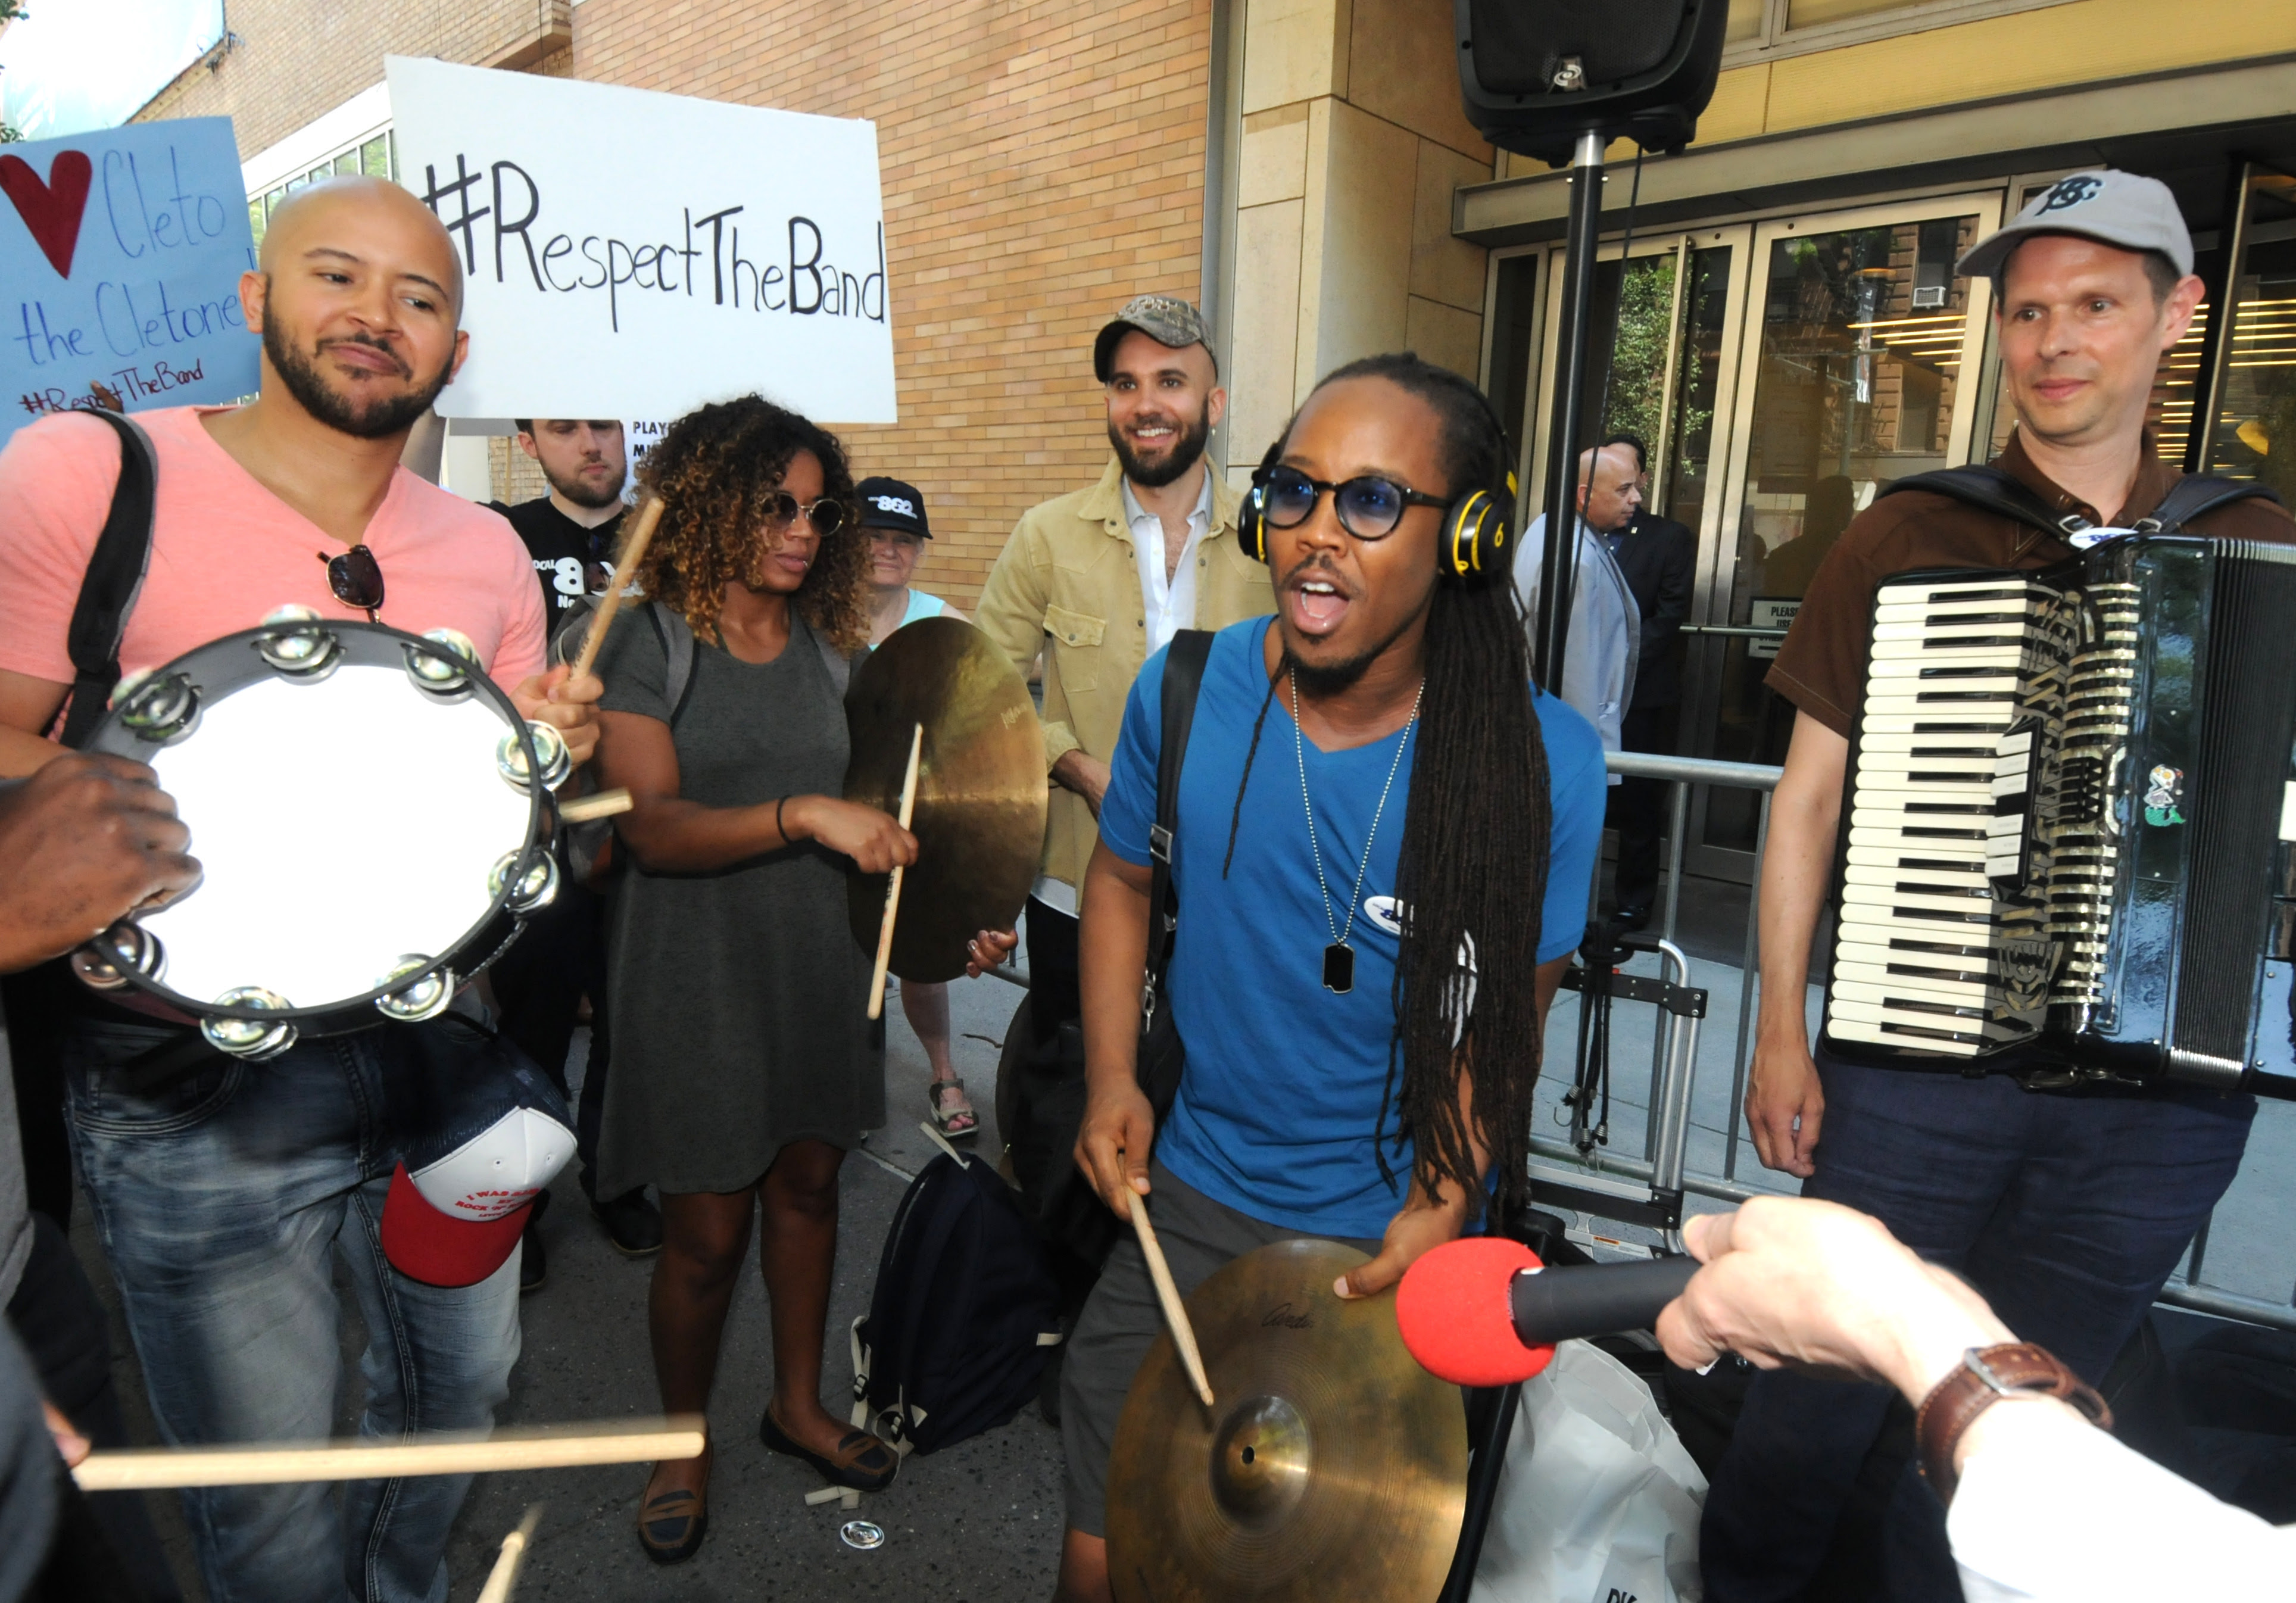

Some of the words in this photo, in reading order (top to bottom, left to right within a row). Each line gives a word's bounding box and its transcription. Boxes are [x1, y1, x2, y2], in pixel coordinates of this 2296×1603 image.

[102, 146, 226, 258] Cleto
[421, 154, 885, 332] #RespectTheBand
[13, 301, 93, 366] the
[95, 280, 242, 357] Cletone
[533, 559, 556, 570] OCAL
[454, 1200, 489, 1211] ROCK
